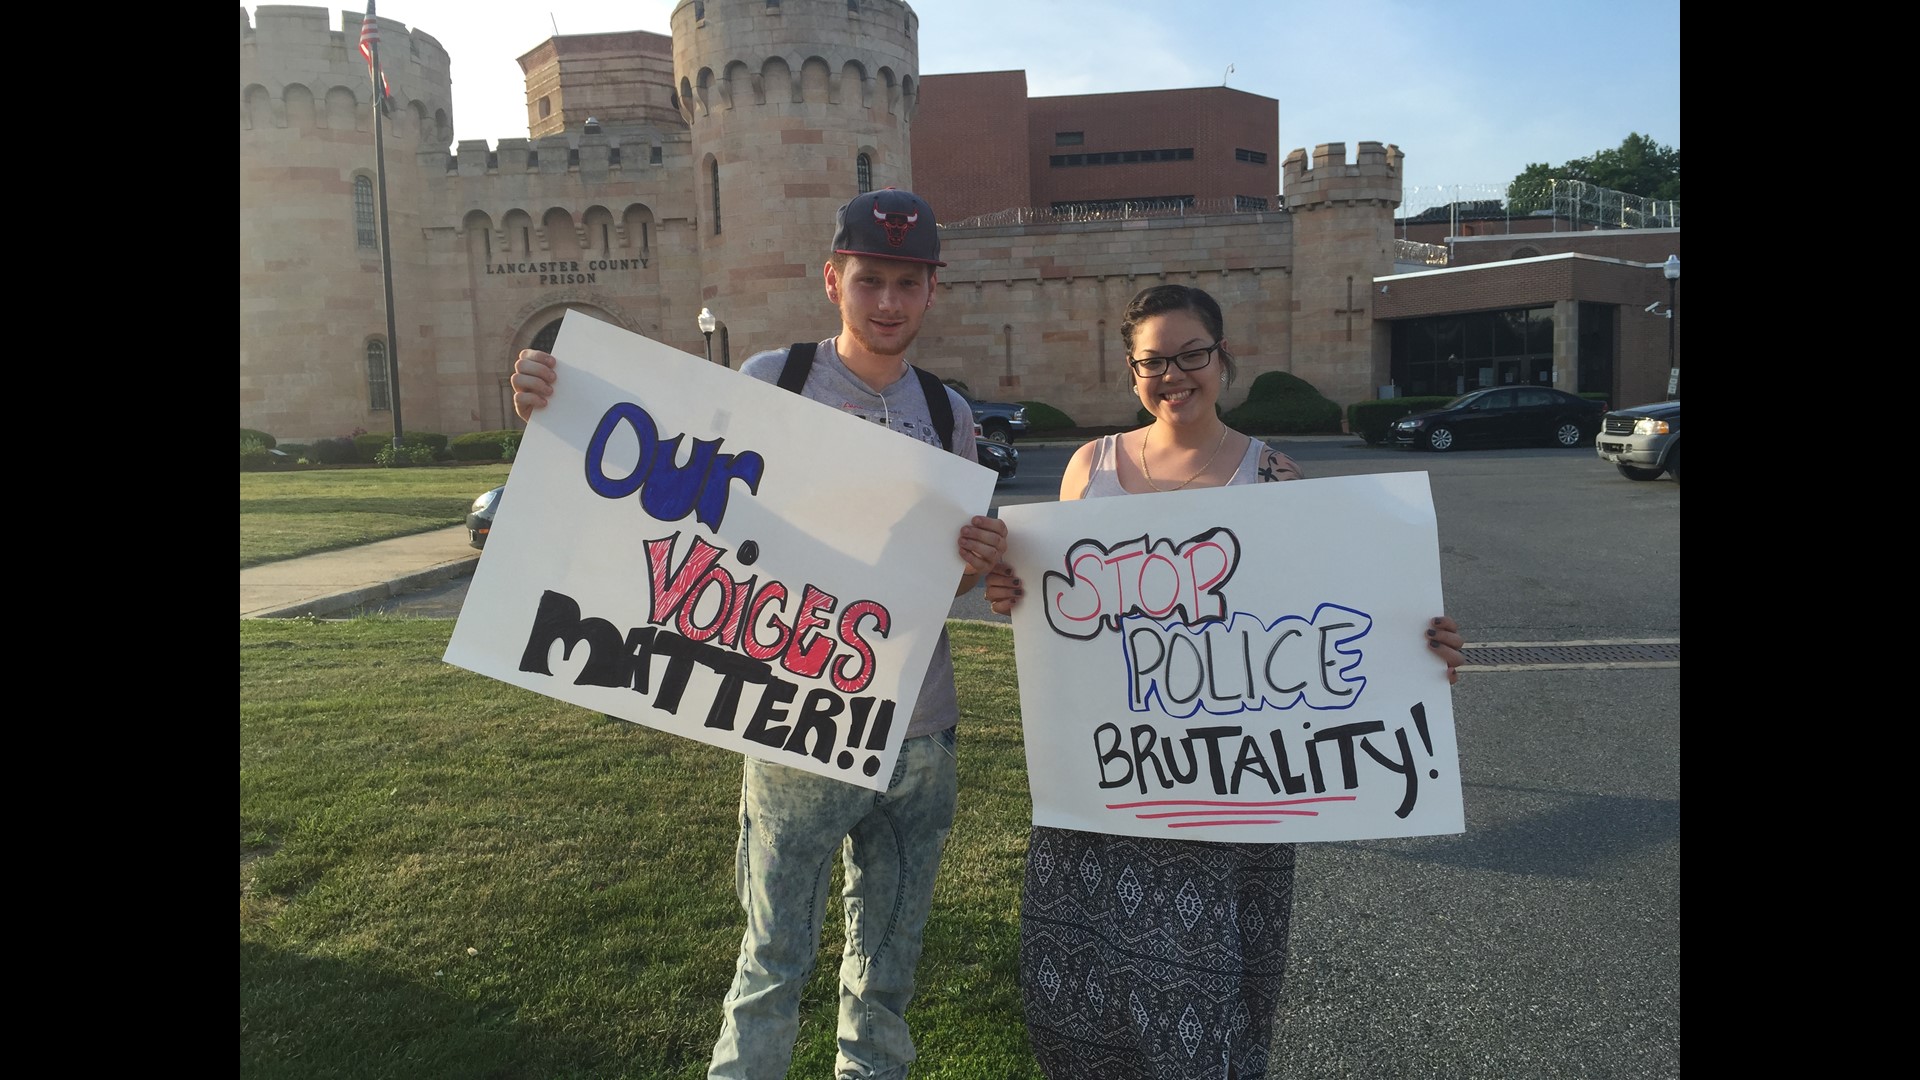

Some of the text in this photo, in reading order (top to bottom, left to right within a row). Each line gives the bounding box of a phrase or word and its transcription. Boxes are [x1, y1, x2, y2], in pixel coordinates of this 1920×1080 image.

[486, 258, 649, 274] LANCASTER COUNTY
[539, 273, 596, 285] PRISON
[1043, 527, 1240, 641] STOP
[1121, 603, 1372, 718] POLICE
